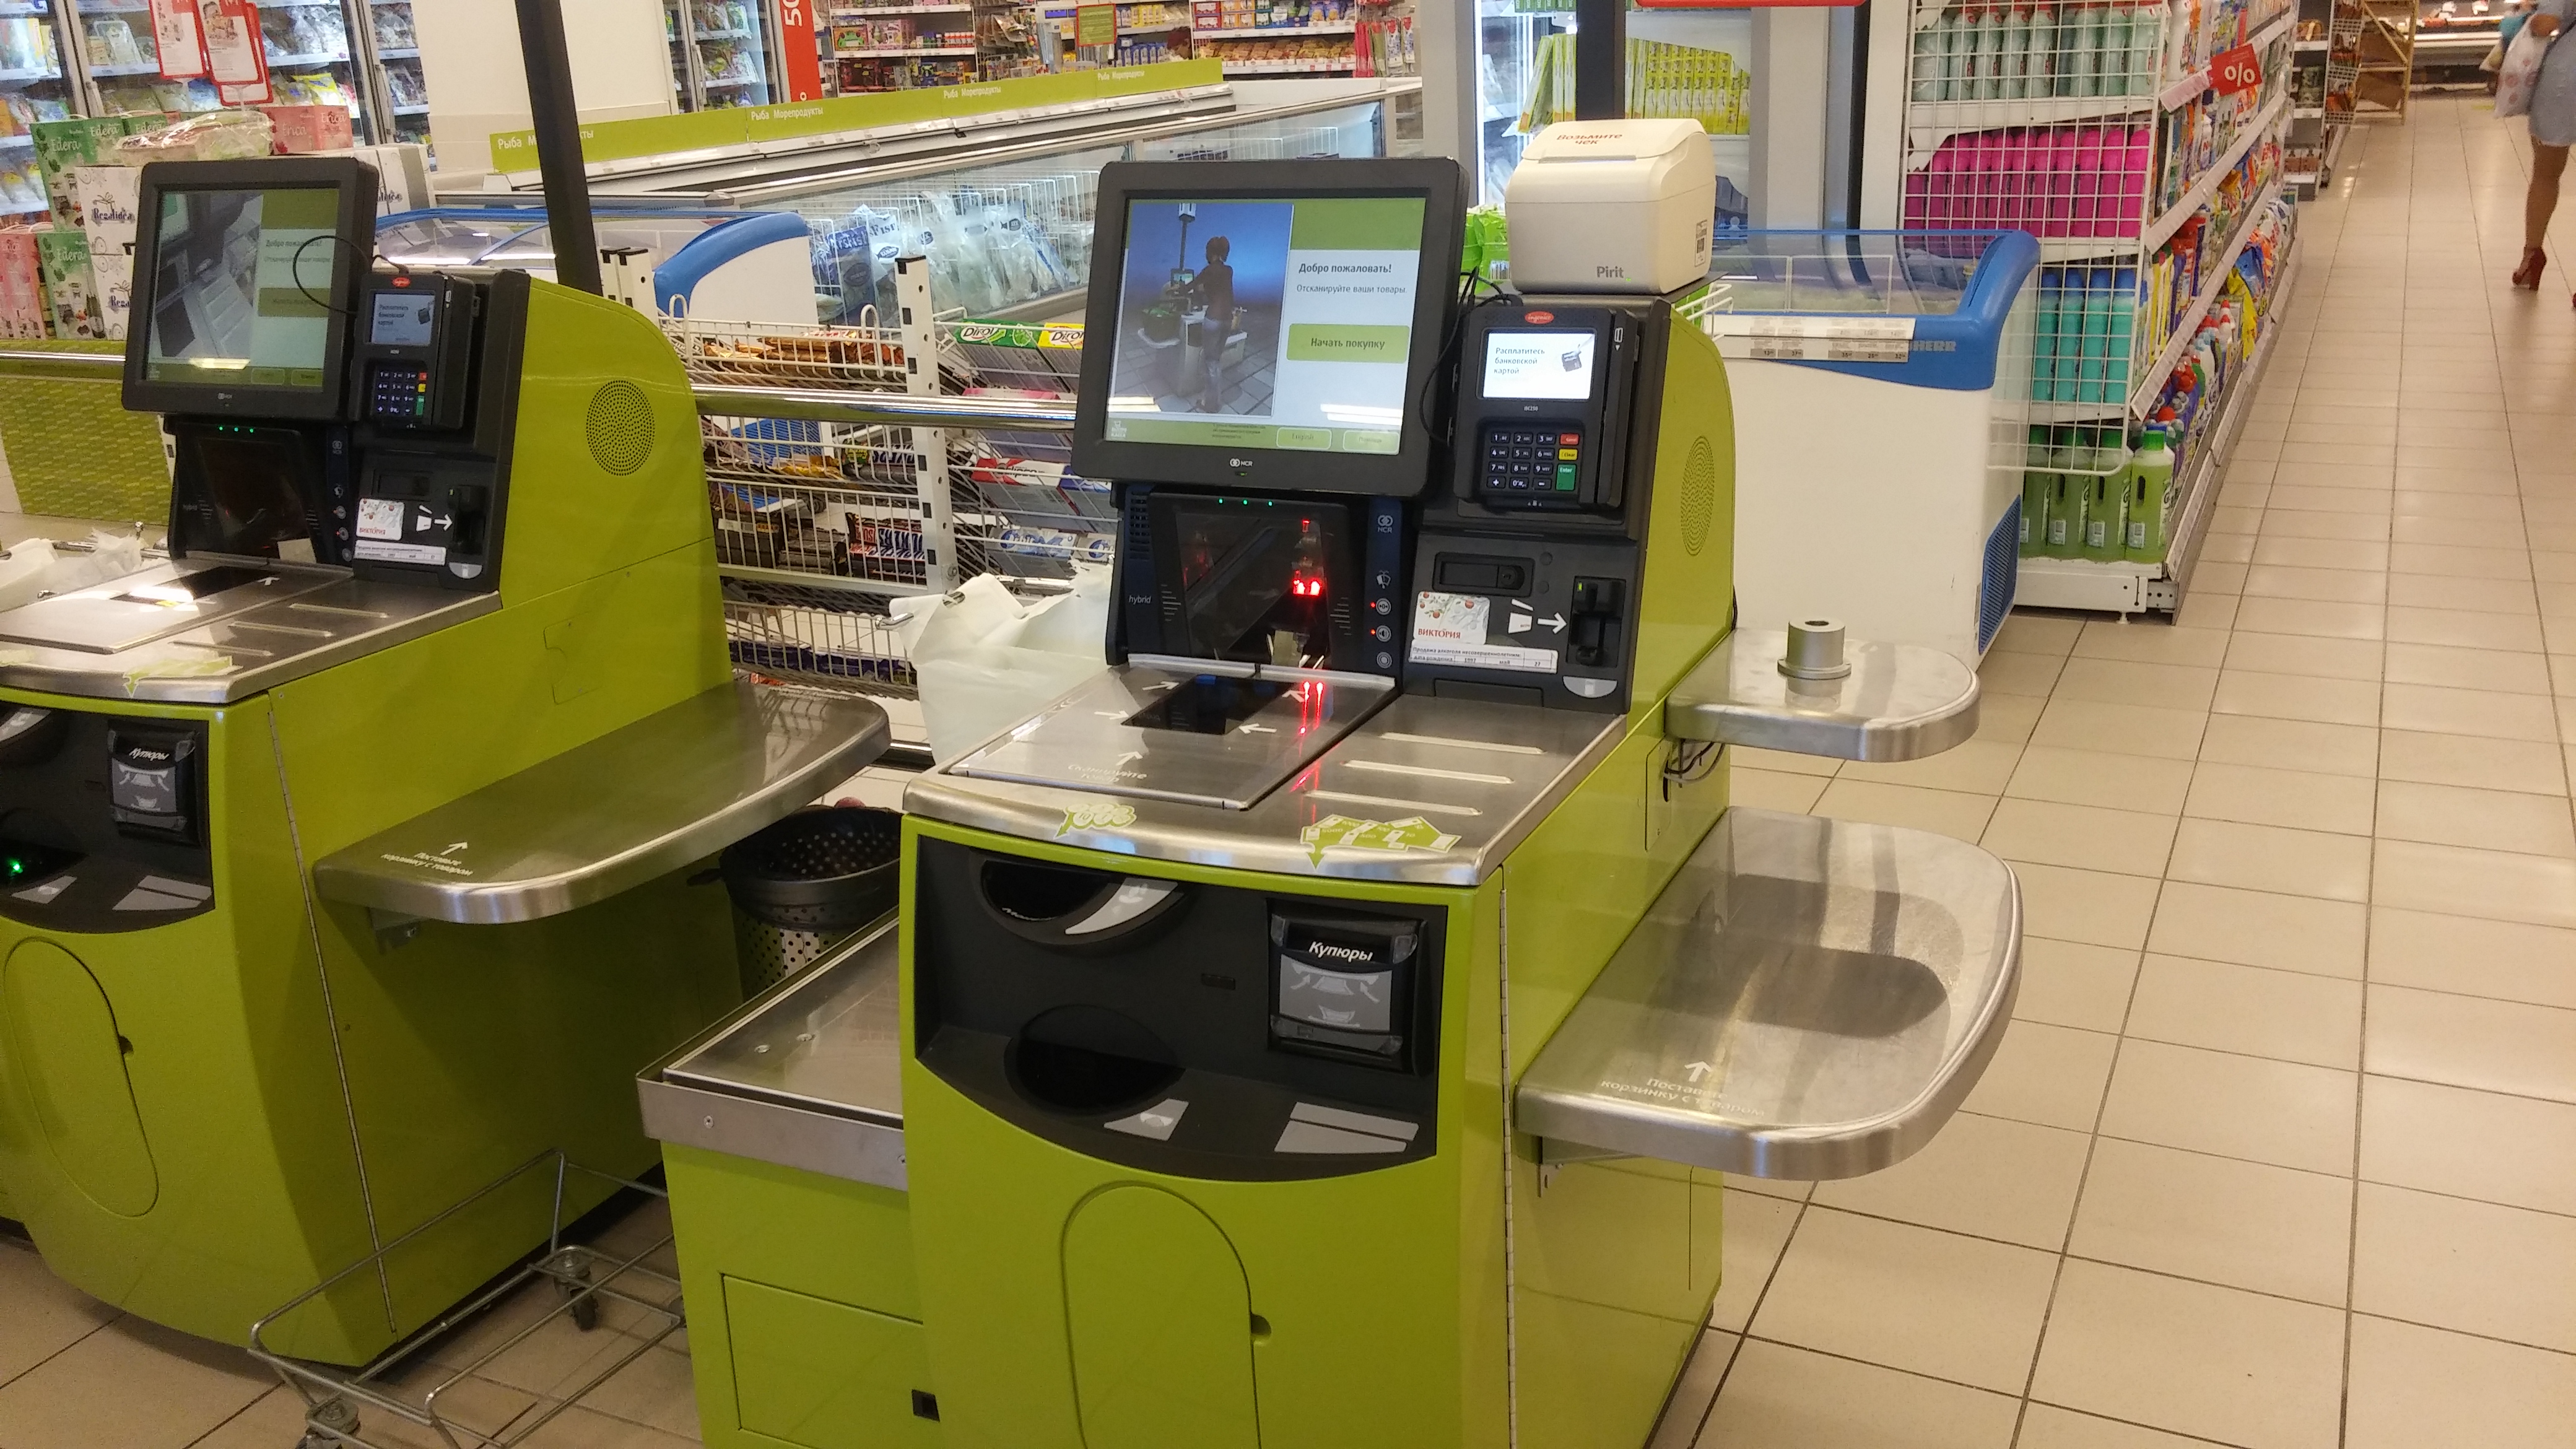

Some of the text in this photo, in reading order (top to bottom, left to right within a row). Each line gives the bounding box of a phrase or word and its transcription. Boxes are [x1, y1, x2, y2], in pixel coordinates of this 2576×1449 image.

[943, 86, 1002, 99] Рыба Морепродукты
[751, 106, 824, 122] Рыба Морепродукты
[90, 123, 118, 137] Edera
[282, 123, 307, 137] Erica
[51, 139, 80, 152] Edera
[497, 137, 523, 150] Рыба
[57, 248, 87, 261] Edera
[1299, 263, 1393, 274] Добро пожаловать!
[1596, 266, 1625, 279] Pirit
[1296, 284, 1351, 294] Отсканируйте
[1527, 314, 1552, 324] ingenico
[963, 326, 994, 338] Dirol
[1311, 337, 1386, 350] Начать покупку
[1910, 340, 1957, 352] HERR
[1495, 347, 1546, 355] Расплатитесь
[1494, 357, 1538, 365] банковской
[1494, 367, 1520, 376] картой
[1292, 433, 1314, 442] English
[1240, 459, 1253, 468] NCR
[1128, 594, 1152, 605] hybrid
[1418, 628, 1461, 640] ВИКТОРИЯ
[129, 747, 170, 762] Купюры
[1308, 939, 1374, 964] Купюры
[1600, 1079, 1679, 1102] корзинку
[1681, 1095, 1692, 1103] с
